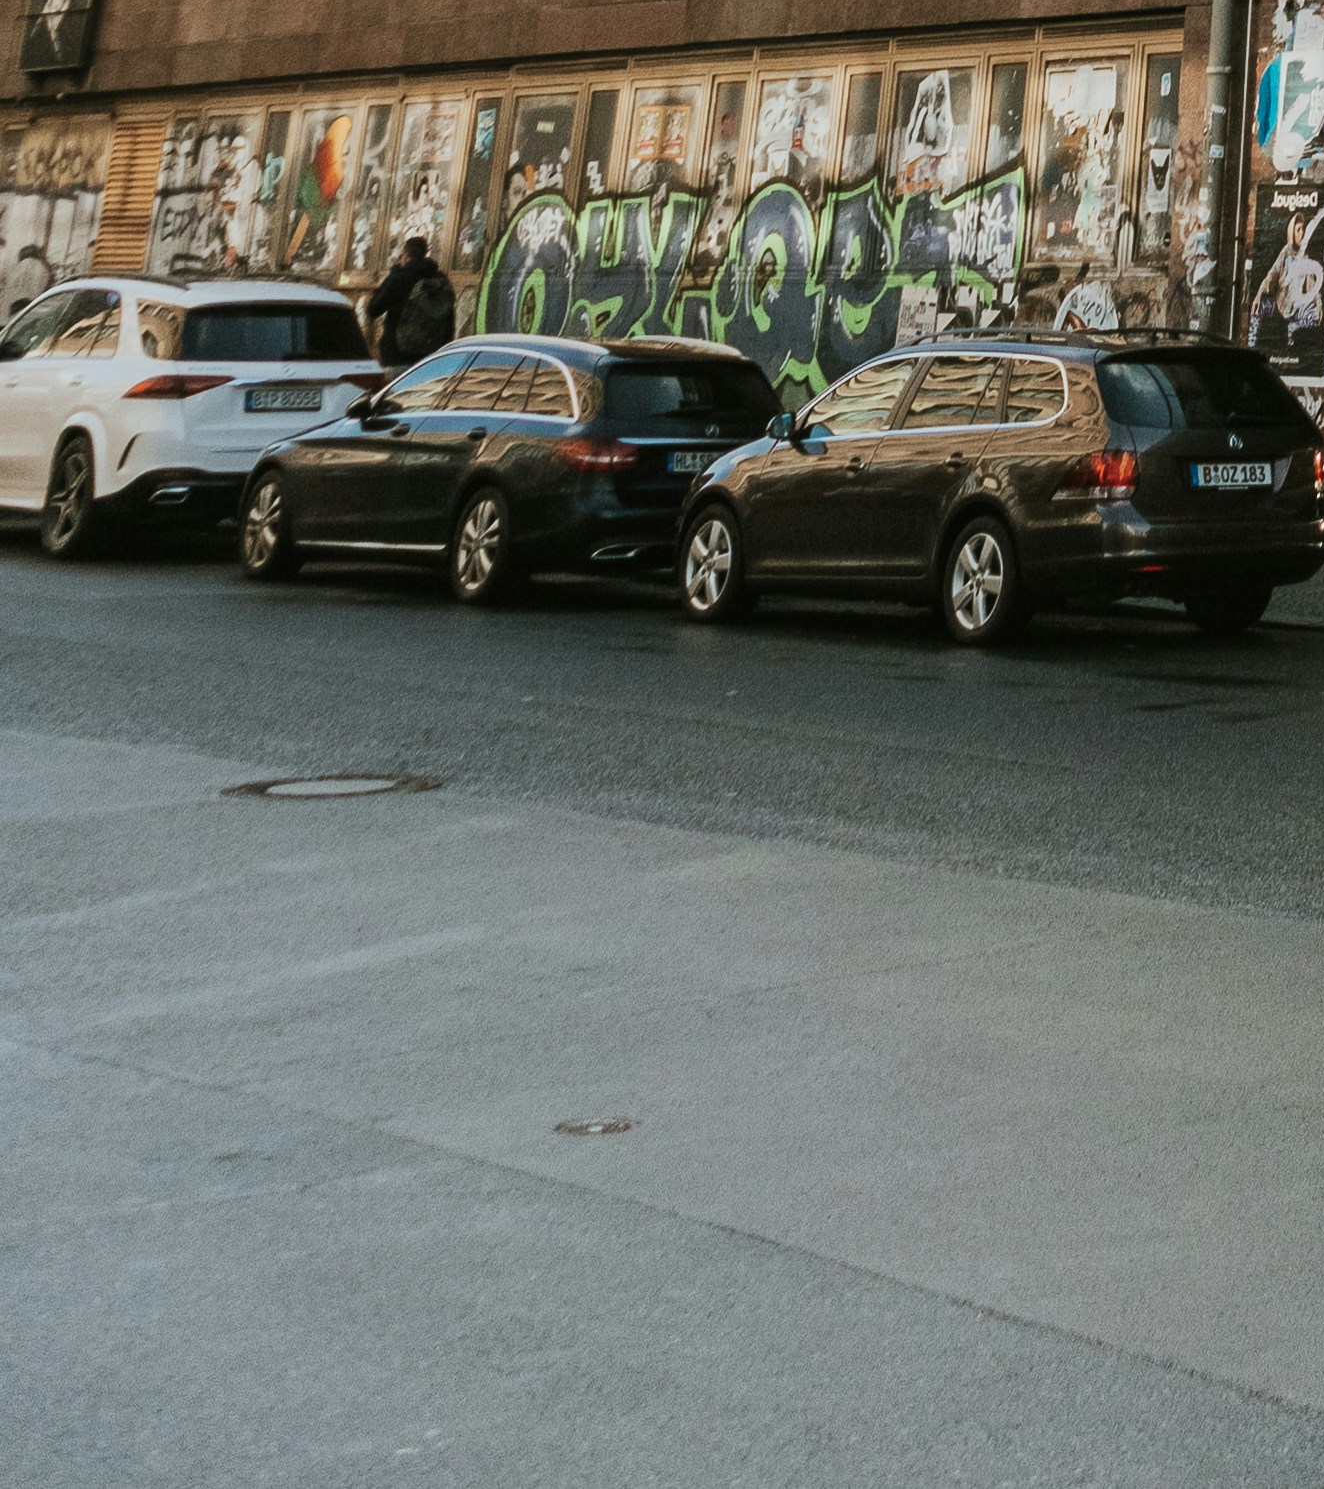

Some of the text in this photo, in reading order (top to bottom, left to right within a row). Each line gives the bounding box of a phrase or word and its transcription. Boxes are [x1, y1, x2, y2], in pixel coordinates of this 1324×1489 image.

[1203, 466, 1265, 484] B OZ 183
